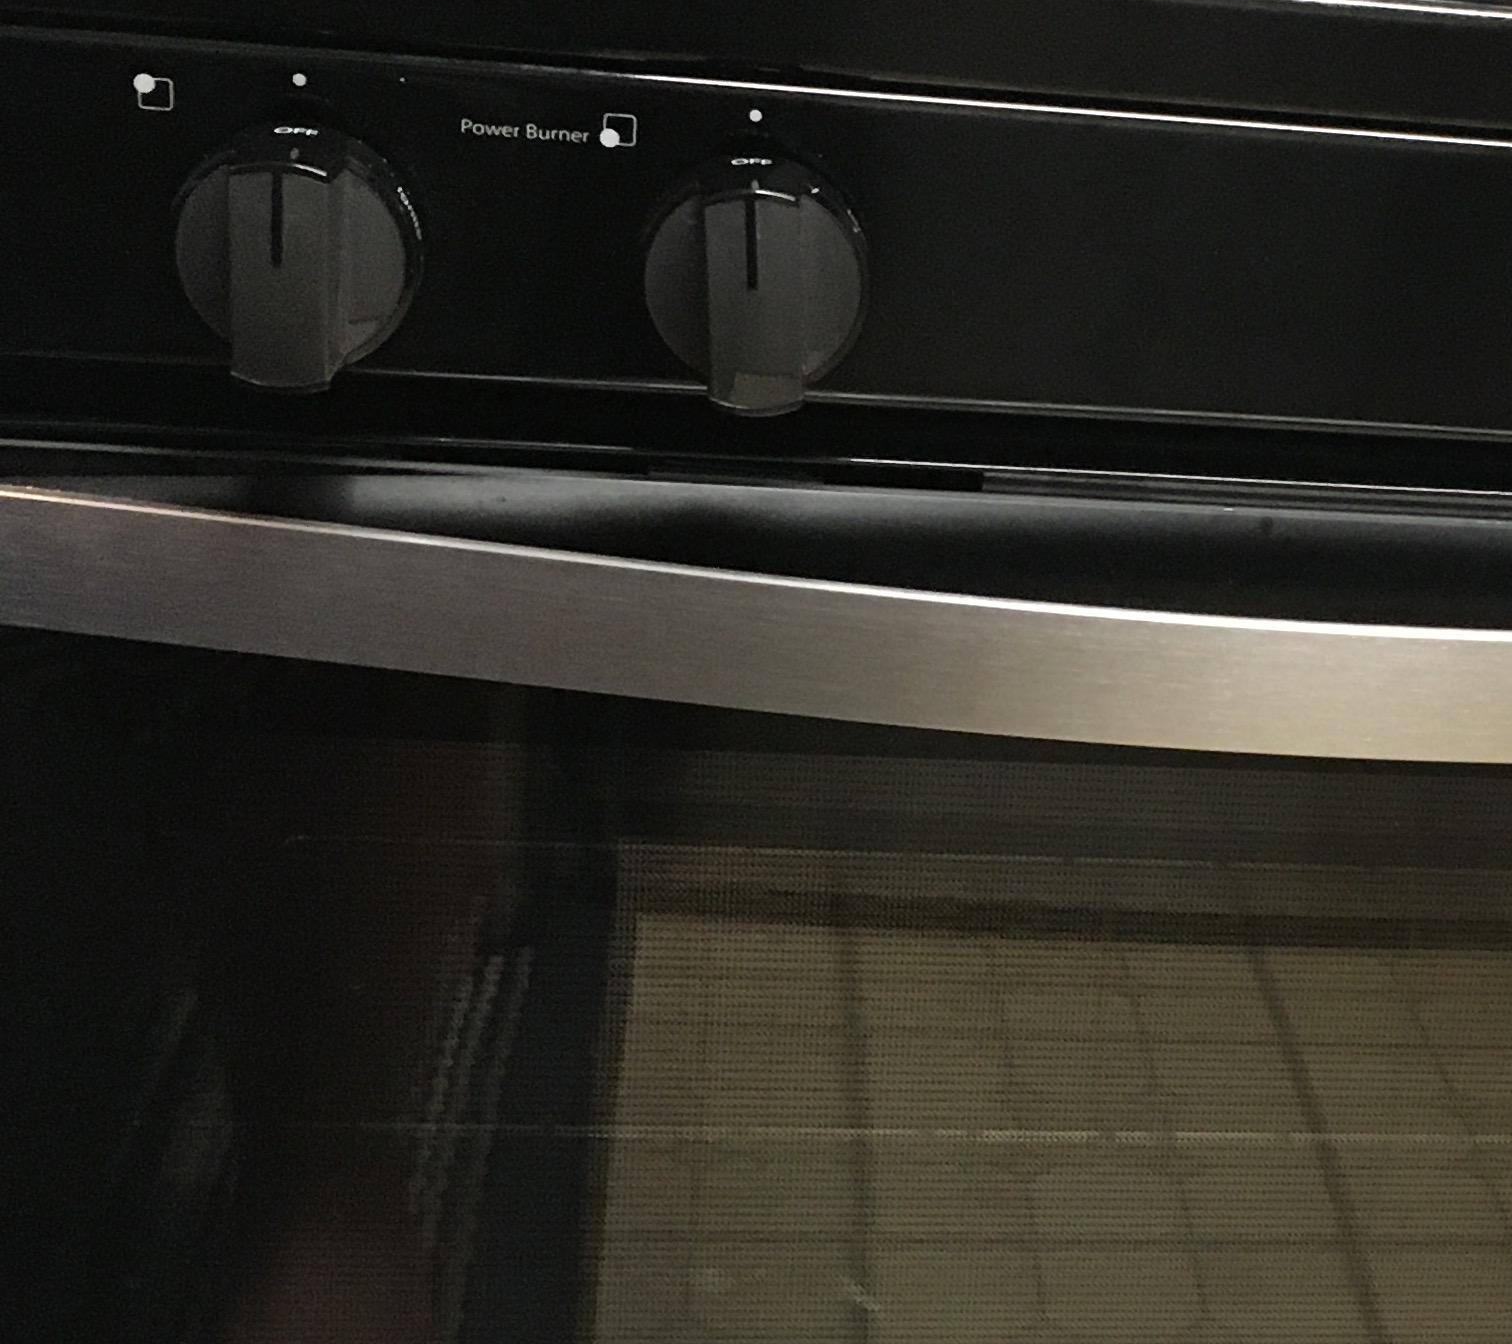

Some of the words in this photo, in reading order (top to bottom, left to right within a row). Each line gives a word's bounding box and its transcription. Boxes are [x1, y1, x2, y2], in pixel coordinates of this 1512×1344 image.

[273, 126, 319, 137] OFF
[460, 118, 520, 138] Power
[525, 123, 590, 143] Burner
[730, 157, 773, 166] OFF
